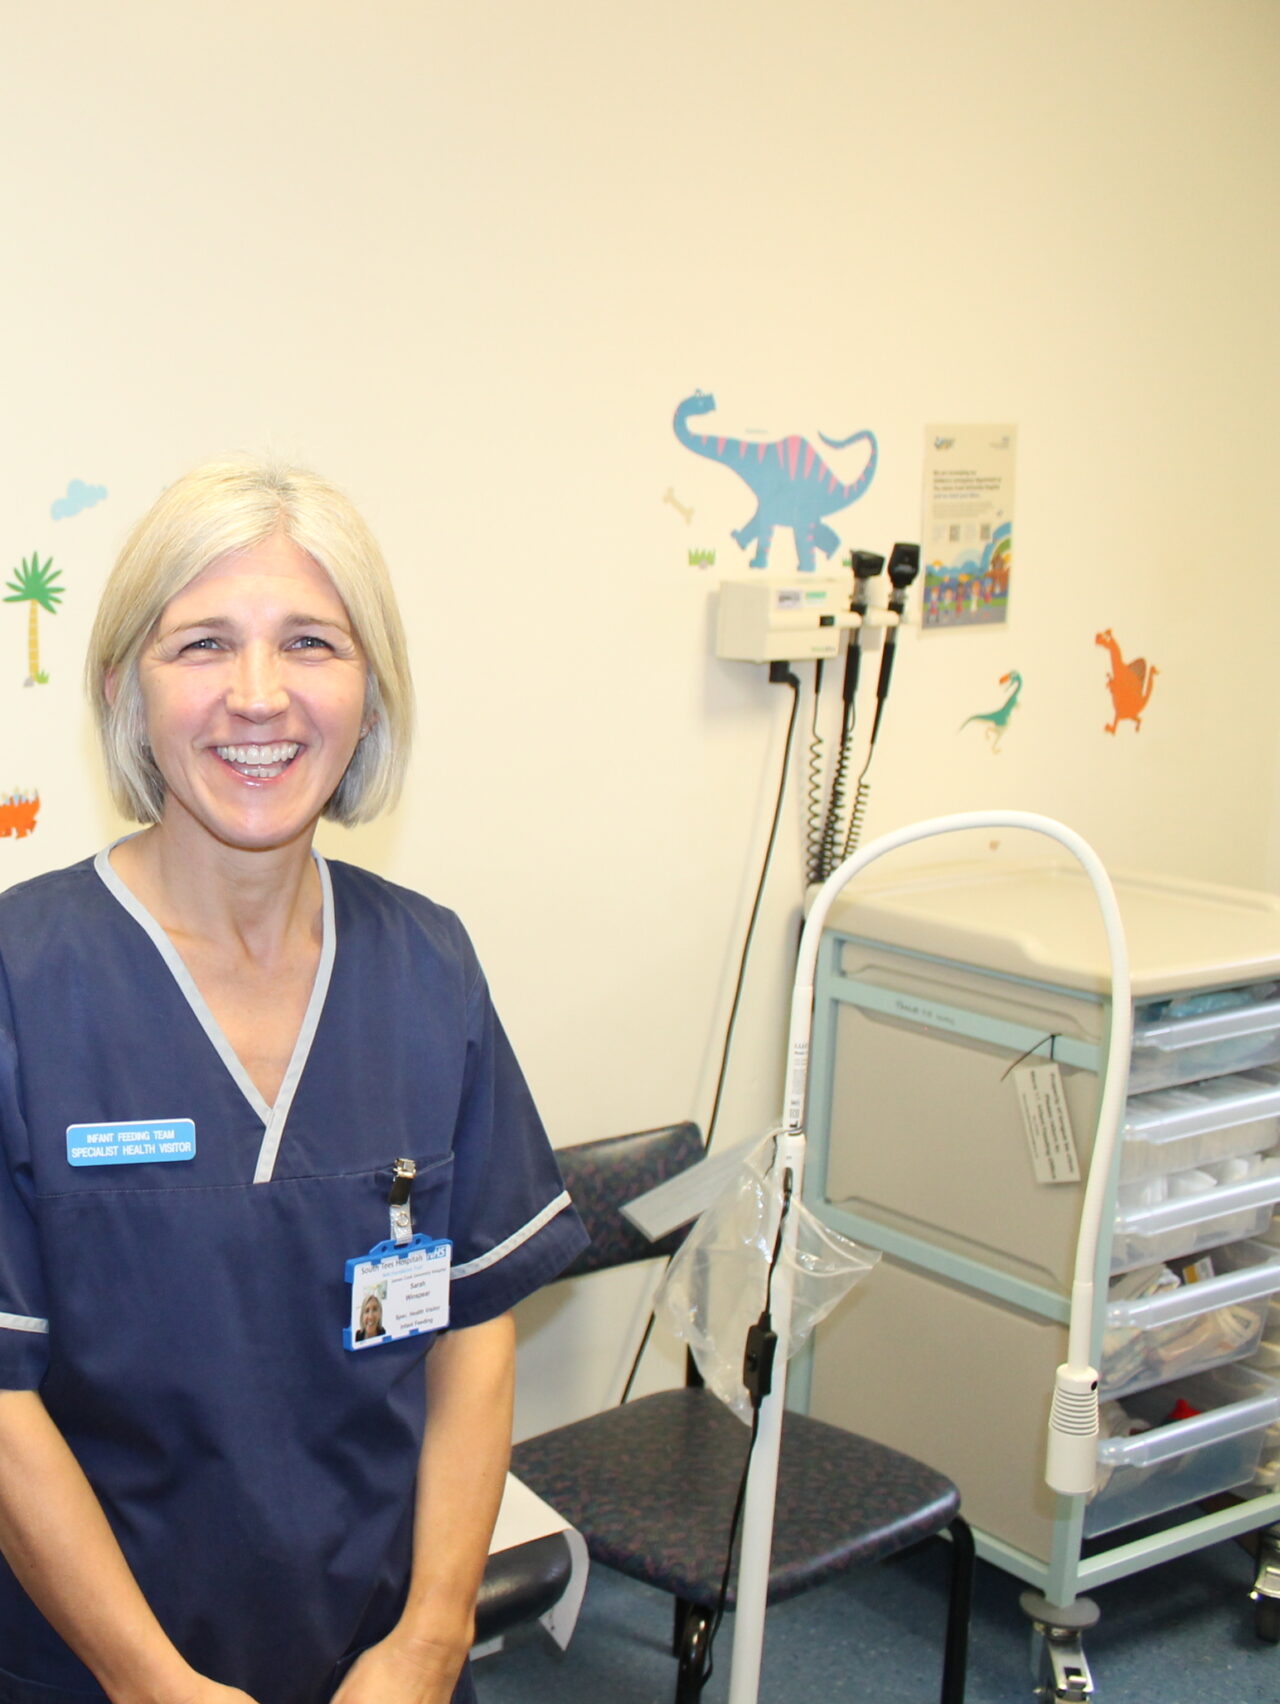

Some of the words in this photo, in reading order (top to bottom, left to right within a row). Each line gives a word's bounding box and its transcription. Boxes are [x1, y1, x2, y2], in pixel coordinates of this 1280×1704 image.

[87, 1133, 114, 1144] INFANT
[118, 1131, 150, 1142] FEEDING
[153, 1130, 175, 1140] TEAM
[71, 1145, 118, 1158] SPECIALIST
[123, 1143, 155, 1155] HEALTH
[159, 1142, 192, 1153] VISITOR
